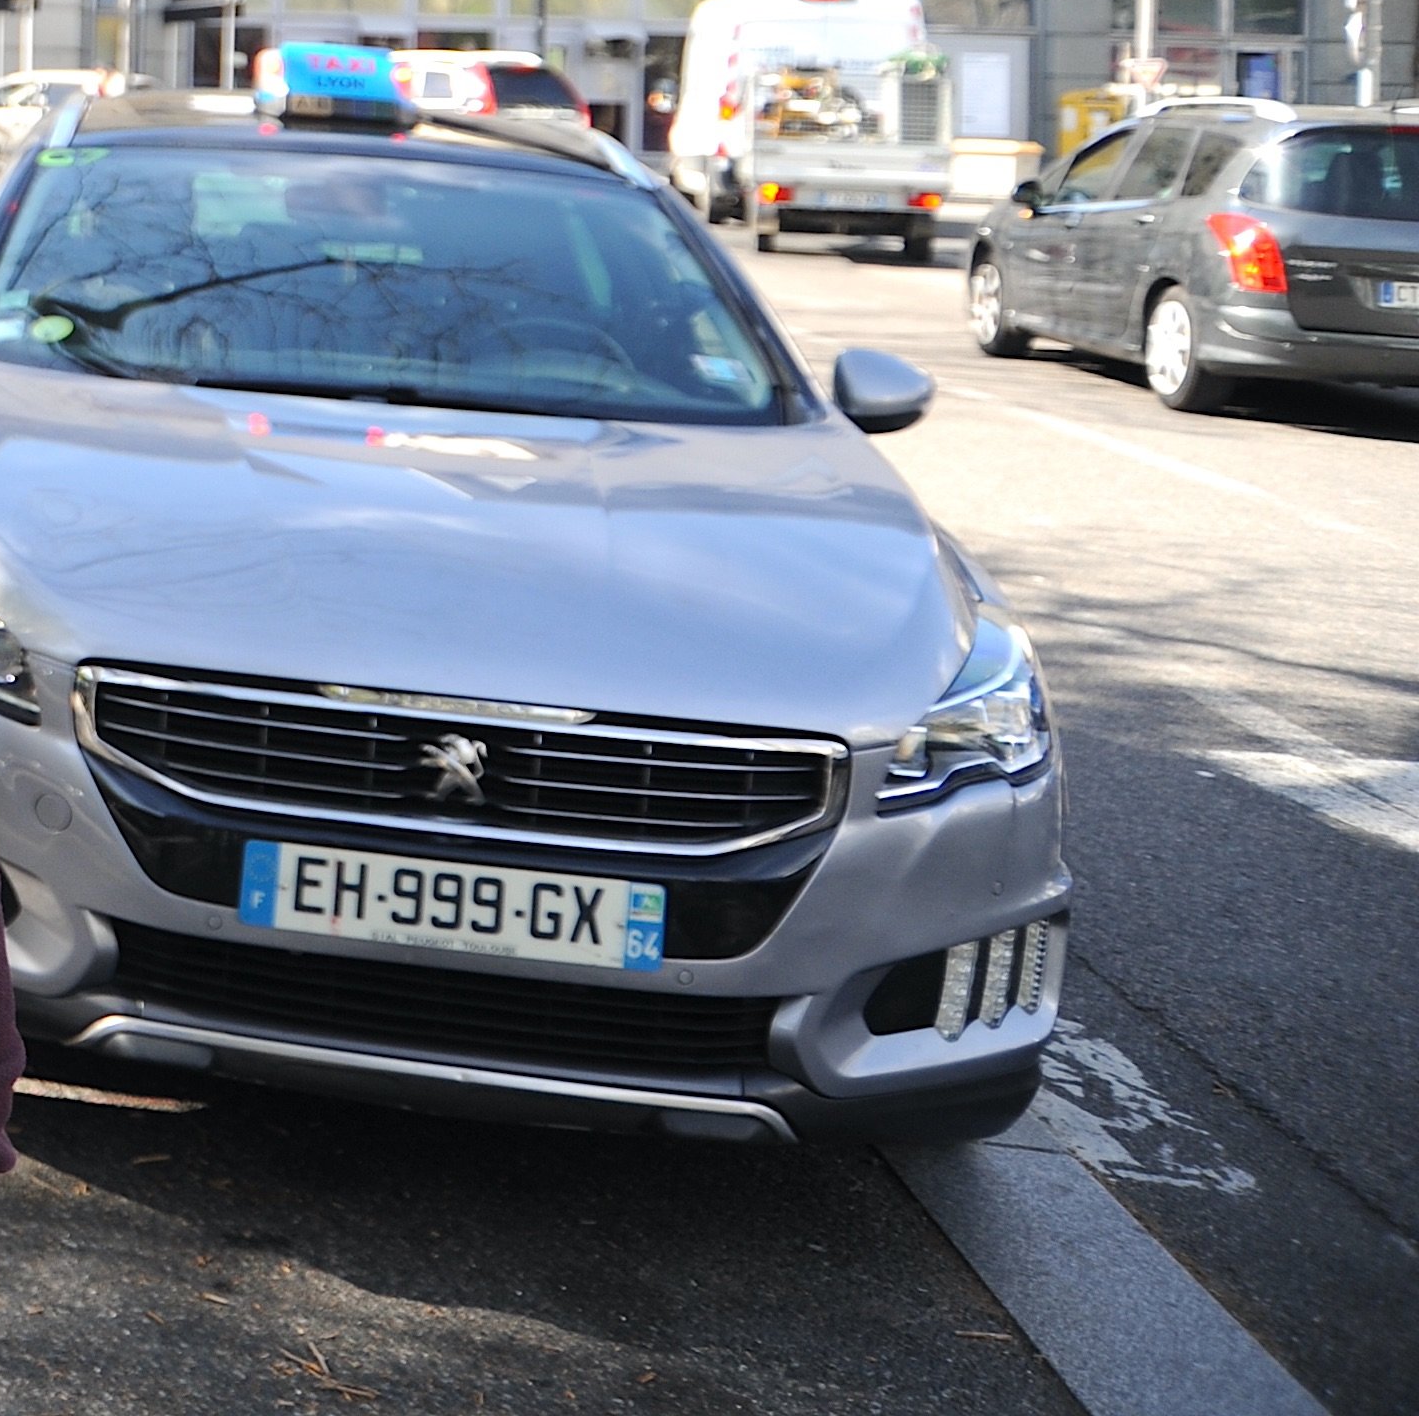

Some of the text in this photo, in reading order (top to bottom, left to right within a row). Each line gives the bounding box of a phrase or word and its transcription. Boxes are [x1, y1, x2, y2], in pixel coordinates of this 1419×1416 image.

[307, 53, 376, 73] TAXI
[315, 76, 366, 89] LYON
[250, 891, 266, 909] F
[293, 856, 605, 946] EH-999-GX
[626, 929, 660, 961] 64
